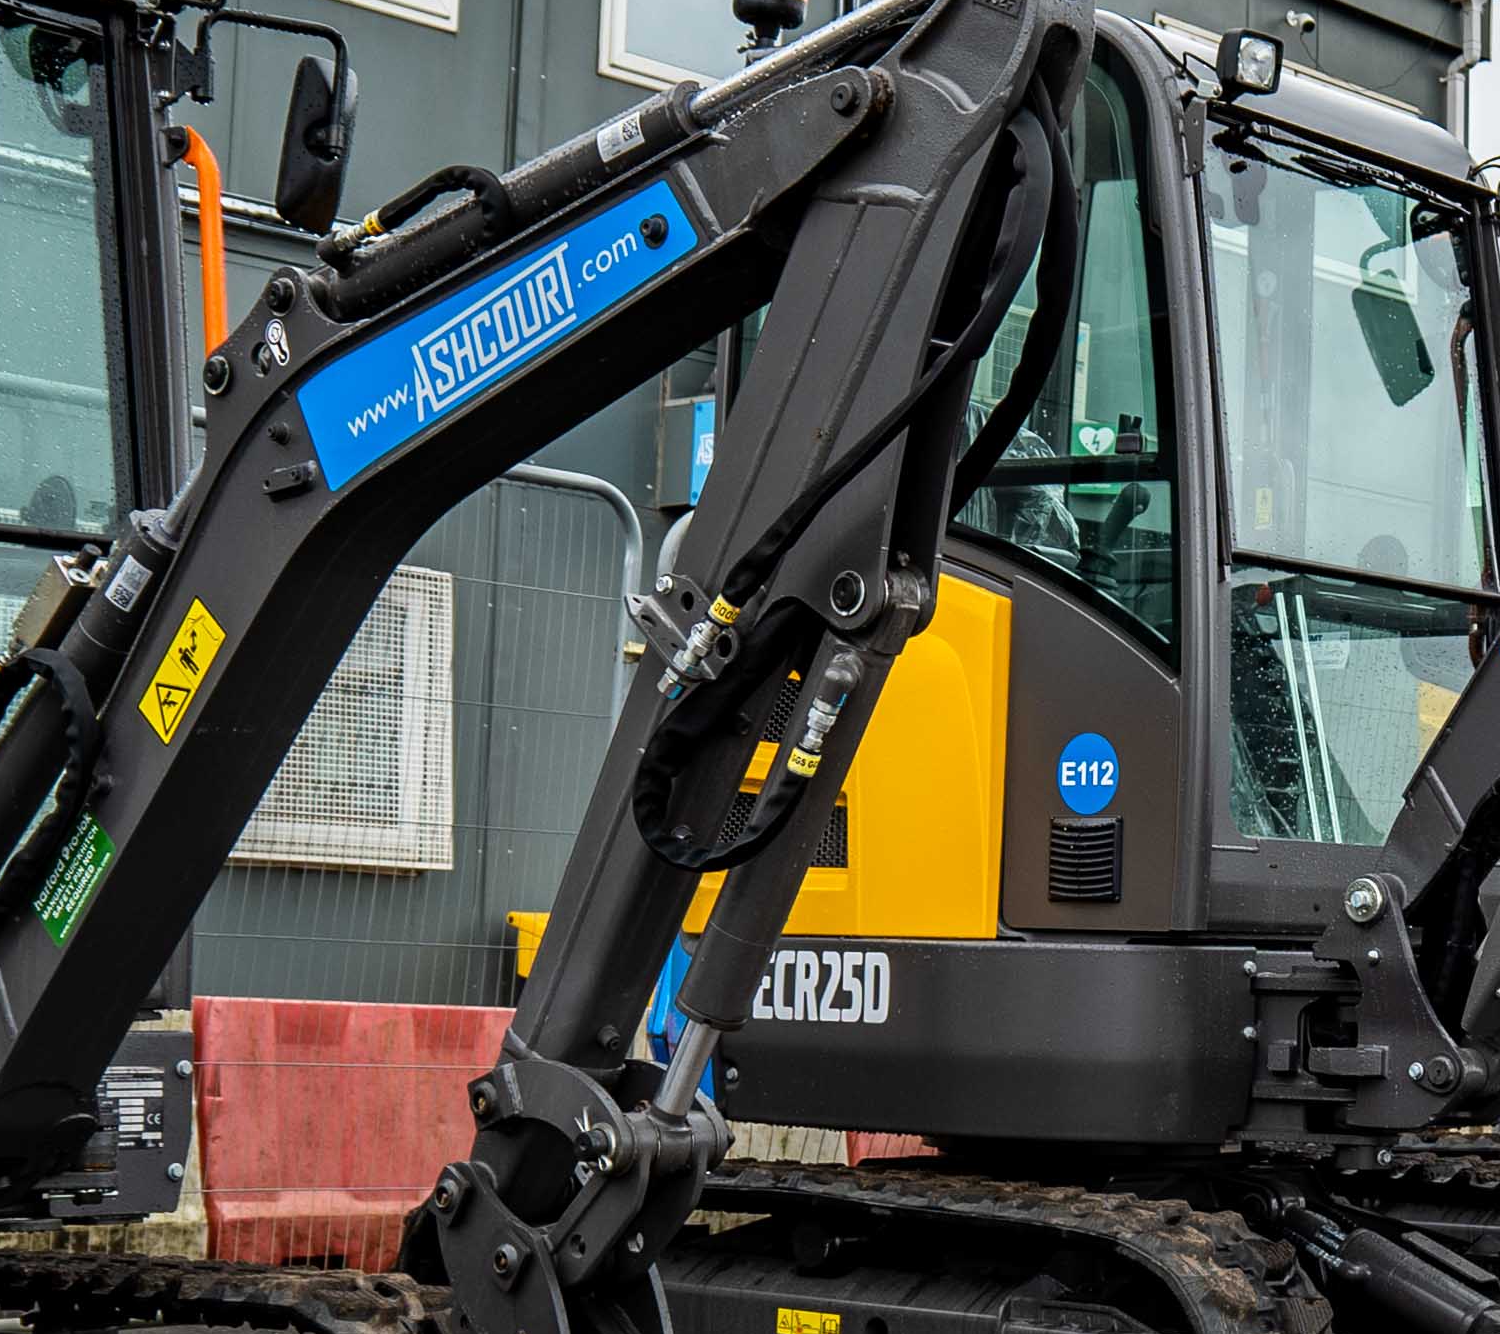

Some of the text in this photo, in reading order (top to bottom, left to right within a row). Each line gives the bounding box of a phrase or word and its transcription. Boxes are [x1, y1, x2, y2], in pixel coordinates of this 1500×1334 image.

[347, 232, 638, 437] www.ASHCOURT.com
[1061, 761, 1114, 786] E112
[33, 858, 66, 912] harford
[41, 825, 99, 921] MANUAL QUICKHITCH
[65, 864, 96, 913] REQUIRED
[52, 879, 76, 919] SAFETY
